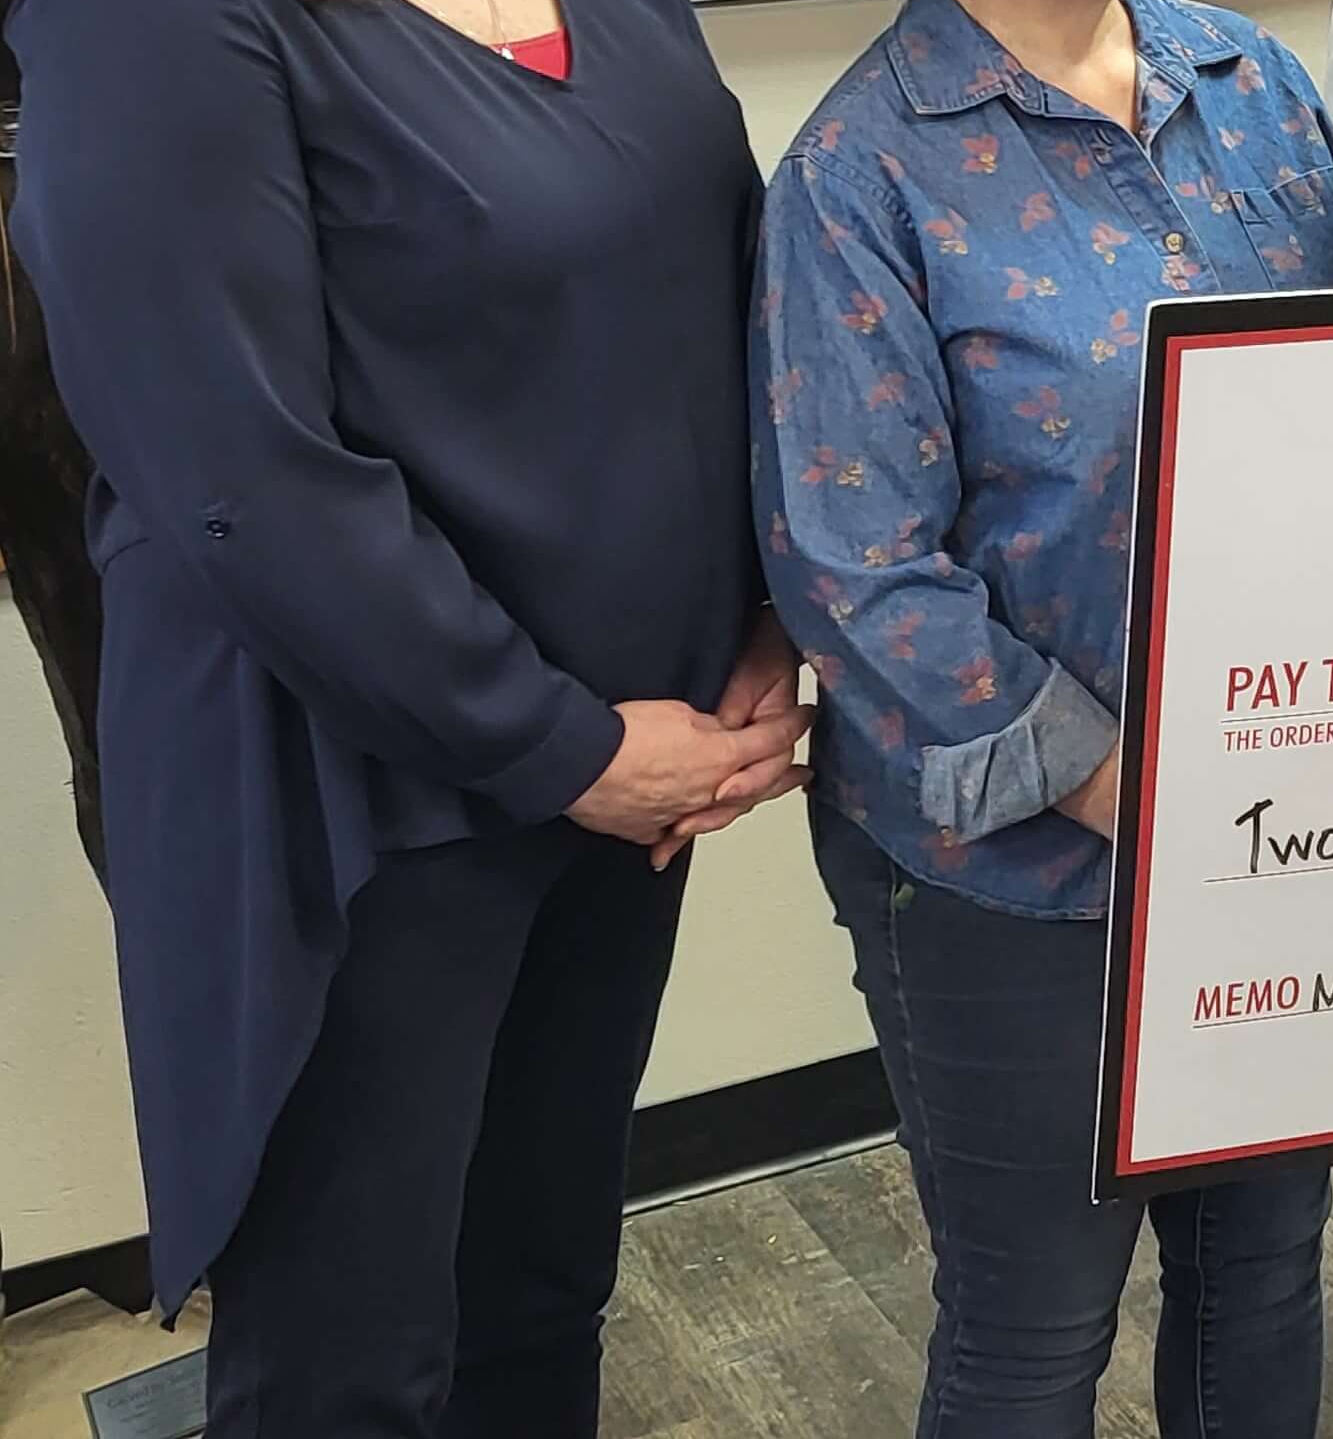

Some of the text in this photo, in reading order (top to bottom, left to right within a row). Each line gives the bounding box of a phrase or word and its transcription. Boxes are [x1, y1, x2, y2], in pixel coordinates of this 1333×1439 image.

[1225, 661, 1309, 713] PAY
[1224, 729, 1264, 753] THE
[1194, 975, 1301, 1022] MEMO
